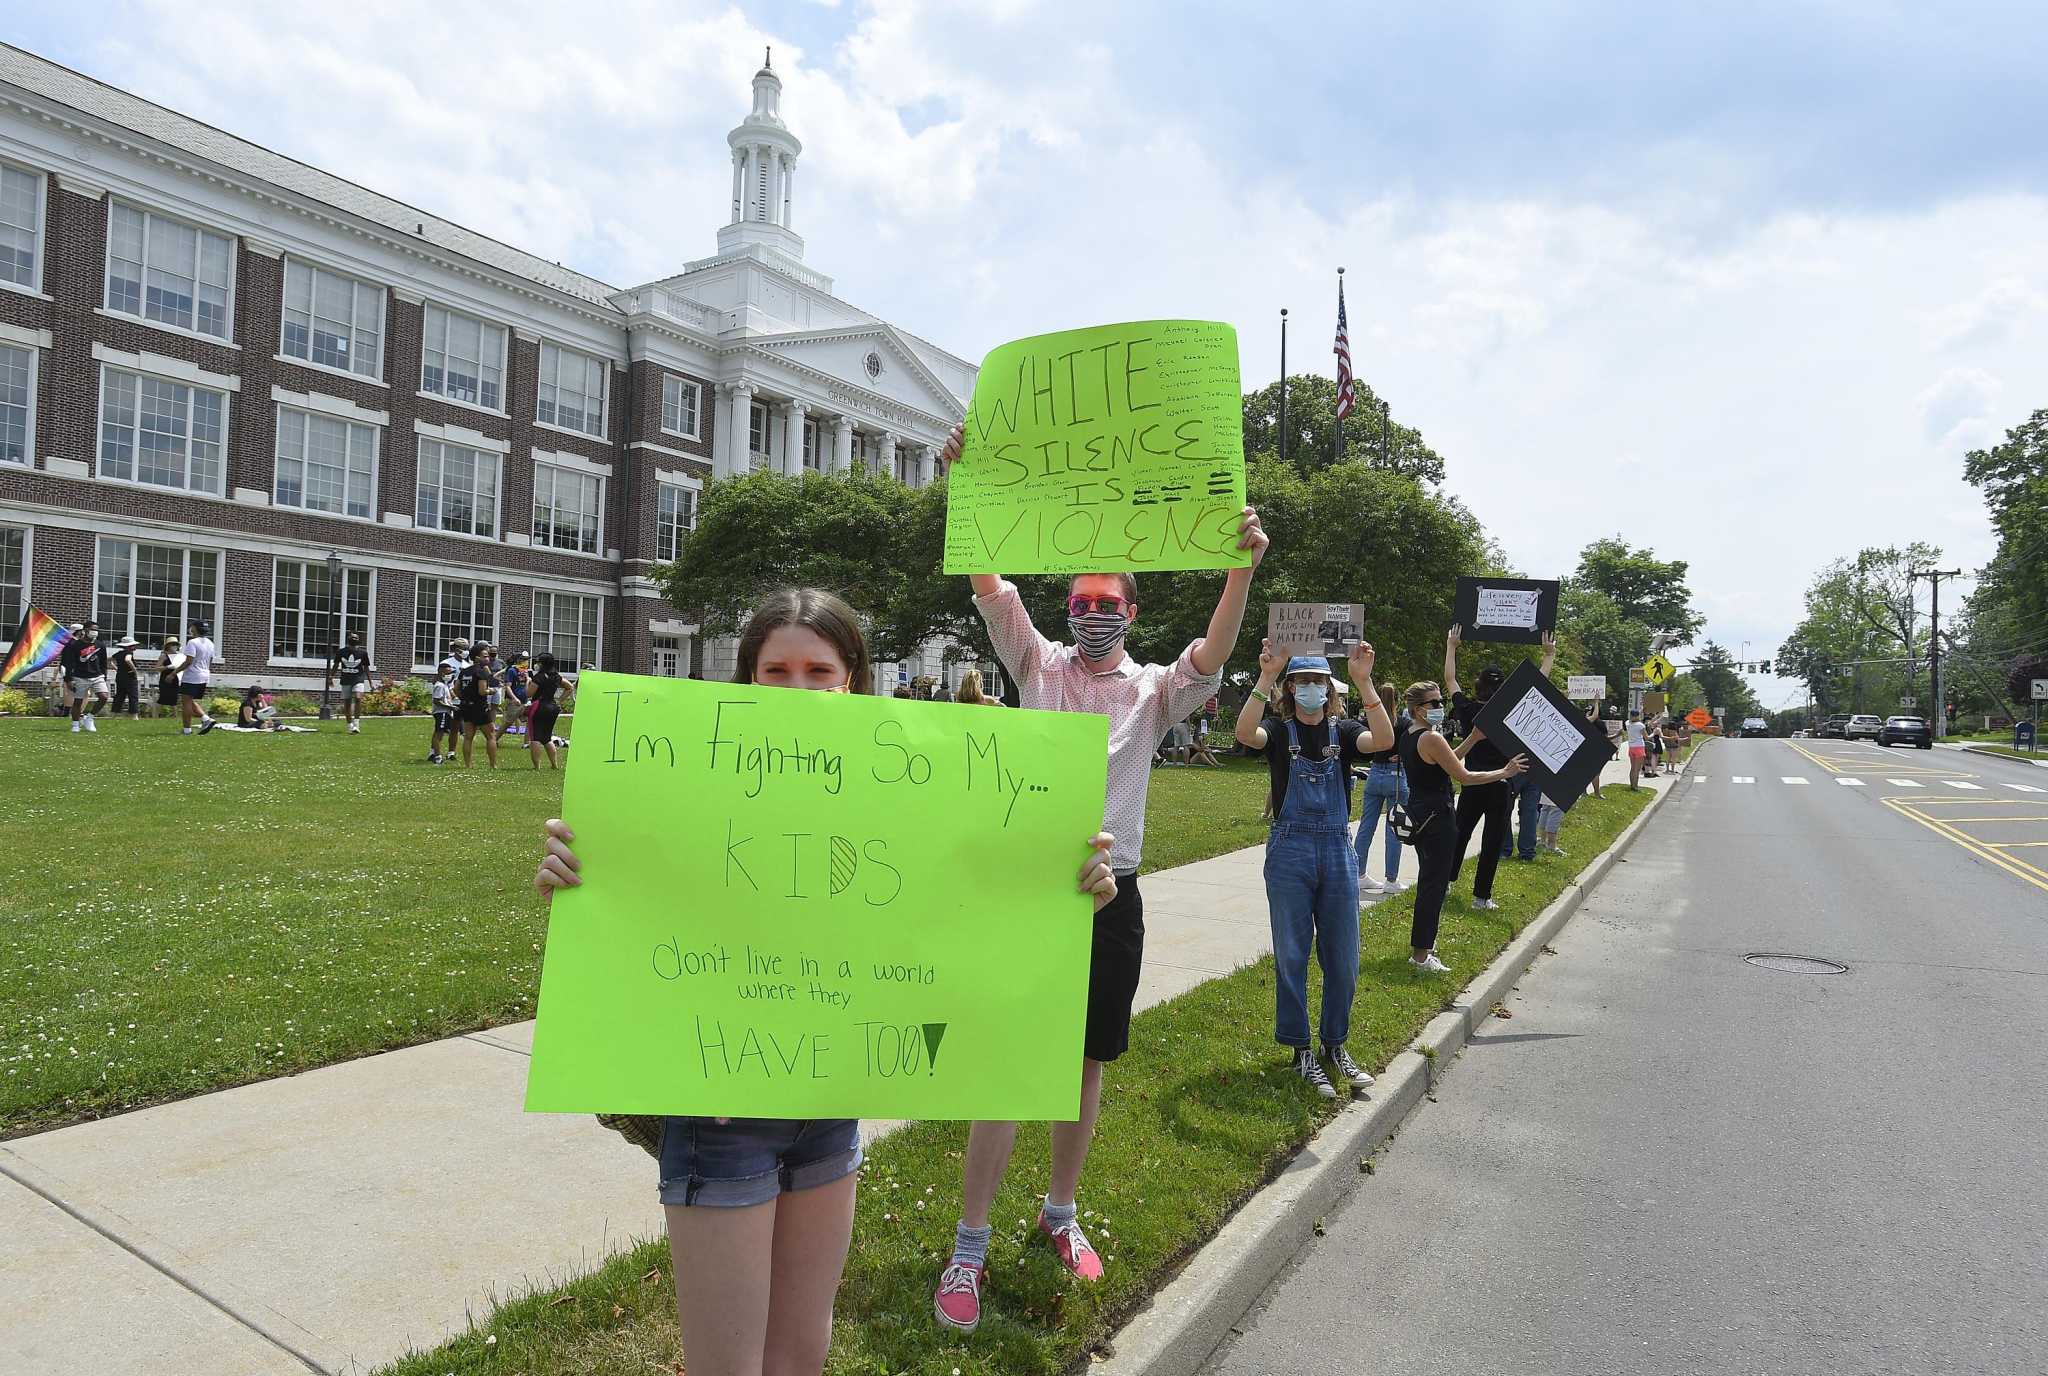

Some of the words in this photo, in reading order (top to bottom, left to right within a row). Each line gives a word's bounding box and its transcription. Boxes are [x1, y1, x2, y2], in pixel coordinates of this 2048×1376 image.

[973, 338, 1162, 441] WHITE
[993, 420, 1230, 487] SILENCE
[1063, 477, 1124, 507] IS
[973, 505, 1245, 562] VIOLENCE
[1280, 607, 1314, 621] BLACK
[603, 690, 675, 767] I'm
[707, 700, 842, 799] Fighting
[872, 720, 932, 785] So
[966, 731, 1050, 828] My...
[725, 818, 902, 907] KIDS
[747, 944, 783, 976] live
[800, 951, 820, 977] in
[838, 960, 852, 978] a
[873, 963, 935, 985] world
[737, 981, 797, 1001] where
[808, 981, 852, 1011] they
[696, 1014, 830, 1079] HAVE
